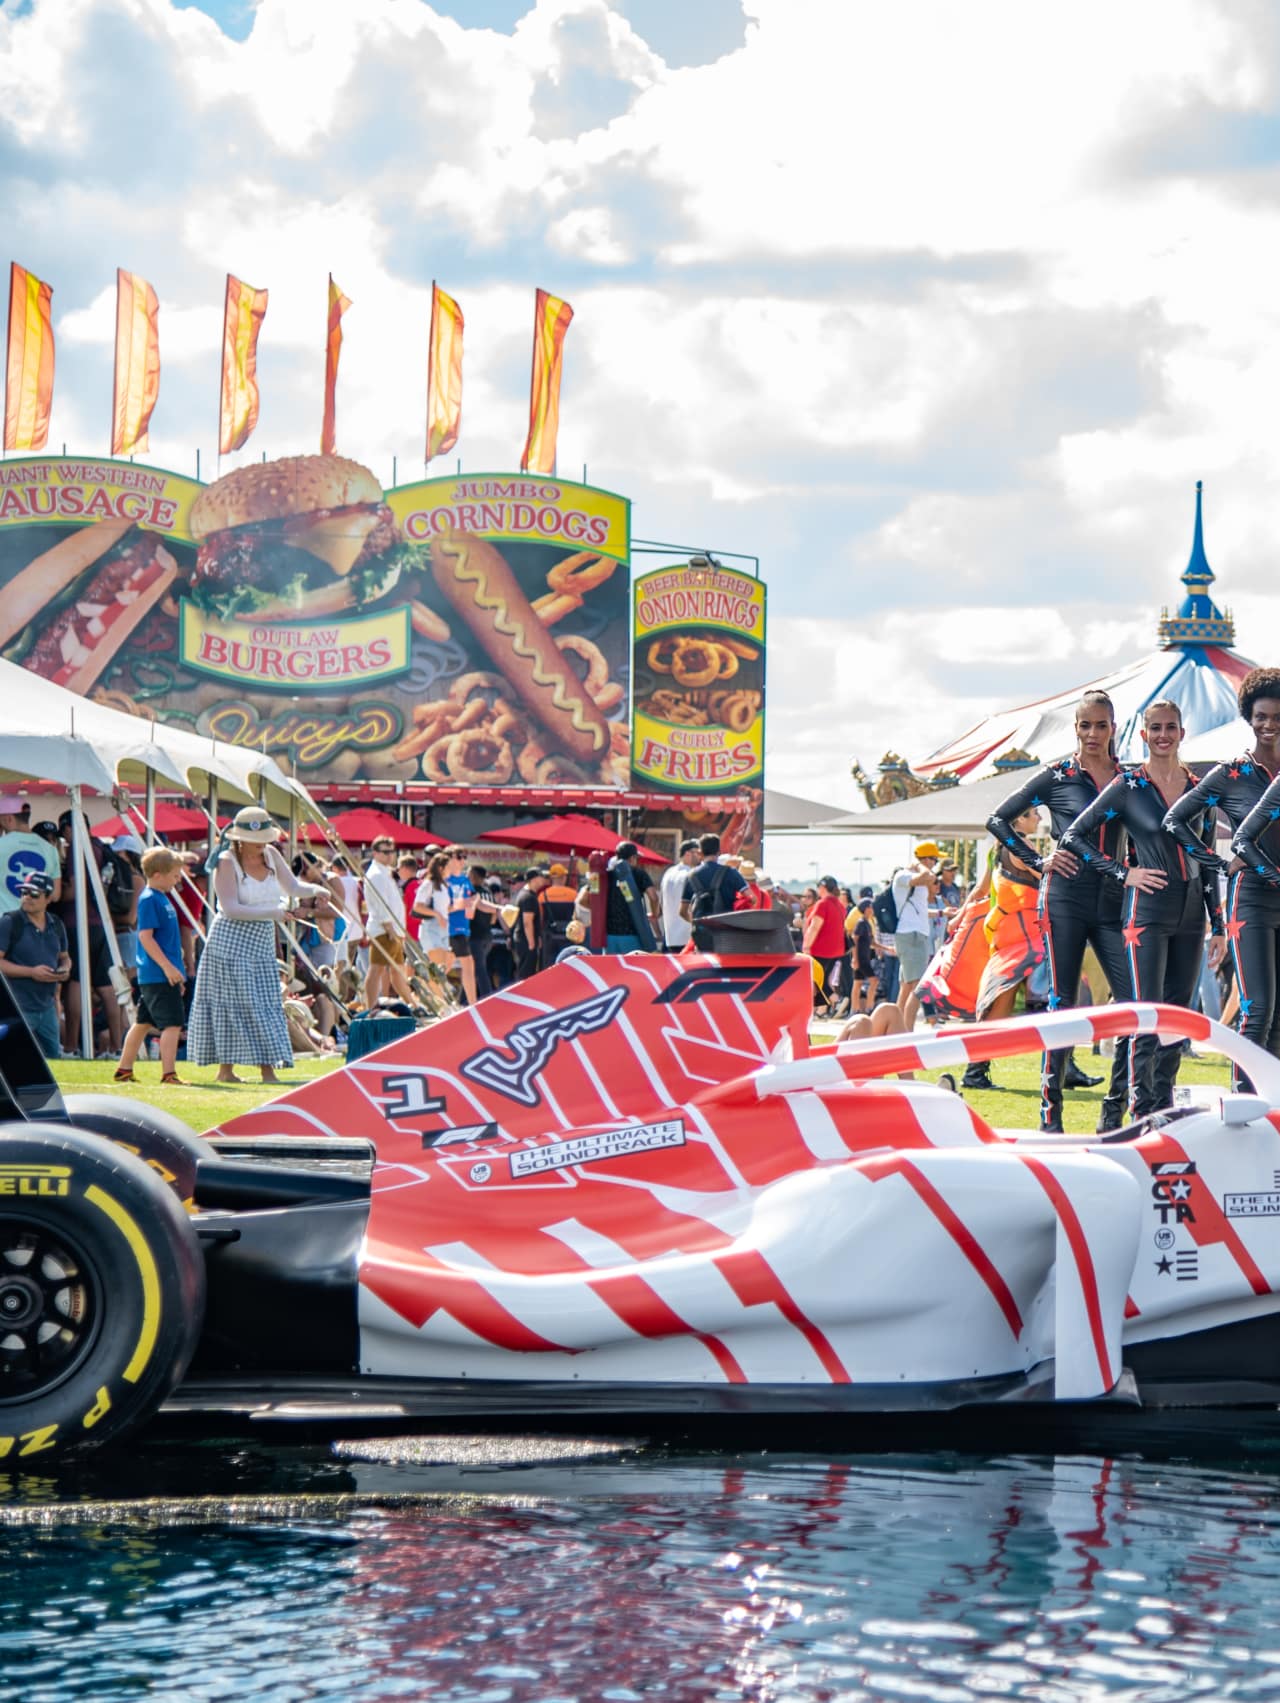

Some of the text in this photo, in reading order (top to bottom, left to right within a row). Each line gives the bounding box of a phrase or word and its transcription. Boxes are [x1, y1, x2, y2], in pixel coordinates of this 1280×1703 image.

[0, 464, 166, 493] IANT WESTERN
[452, 480, 561, 501] JUMBO
[0, 486, 178, 528] AUSAGE
[406, 503, 609, 546] CORN DOGS
[644, 571, 755, 597] BEER BATTERED
[639, 591, 760, 628] ONION RINGS
[200, 632, 393, 679] BURGERS
[252, 628, 339, 647] OUTLAW
[669, 730, 725, 747] CURLY
[639, 740, 757, 780] FRIES
[382, 1073, 447, 1120] 1
[517, 1123, 678, 1161] THE ULTIMATE
[517, 1133, 678, 1174] SOUNDTRACK
[0, 1164, 72, 1196] ELLI
[1229, 1195, 1264, 1205] THE
[83, 1385, 111, 1429] P
